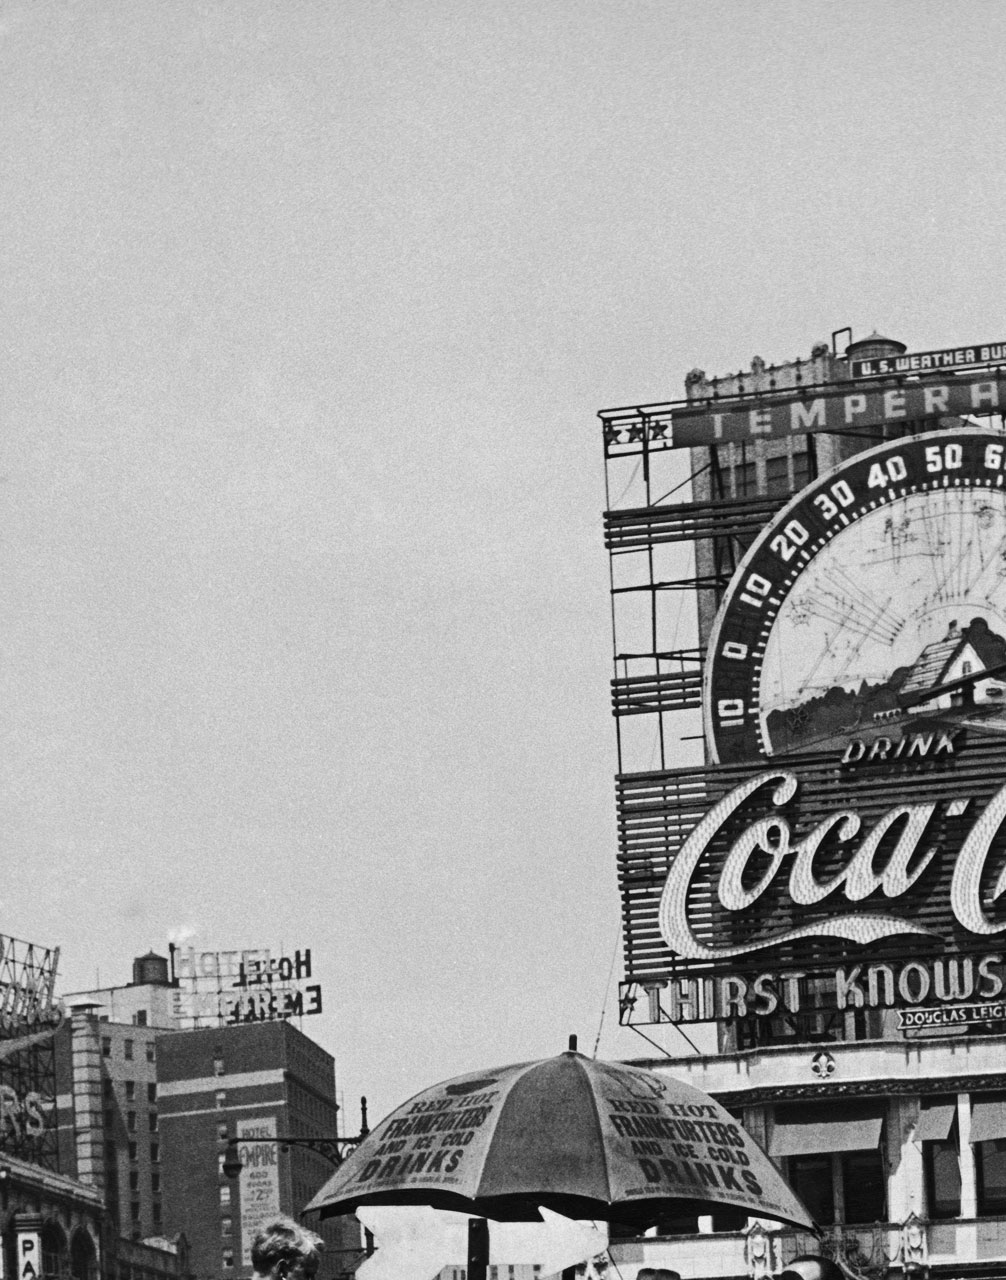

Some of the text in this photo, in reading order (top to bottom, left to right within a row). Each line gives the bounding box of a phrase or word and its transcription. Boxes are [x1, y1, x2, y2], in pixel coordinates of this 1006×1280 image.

[861, 357, 894, 376] U.S.
[895, 348, 976, 371] WEATHER
[722, 641, 748, 661] 0
[740, 572, 772, 609] 10
[769, 519, 811, 564] 20
[813, 480, 856, 520] 30
[867, 455, 908, 490] 40
[924, 443, 963, 472] 50
[841, 728, 959, 764] DRINK
[643, 968, 807, 1024] THIRST
[836, 953, 1004, 1012] KNOWS
[905, 1008, 967, 1025] DOUGLAS
[407, 1089, 500, 1115] RED HOT
[608, 1098, 720, 1120] RED HOT
[379, 1104, 494, 1142] FRANKFURTERS
[608, 1113, 746, 1149] FRANKFURTERS
[374, 1131, 475, 1157] AND ICE COLD
[631, 1140, 751, 1167] AND ICE COLD
[357, 1149, 465, 1183] DRINKS
[637, 1158, 764, 1197] DRINKS
